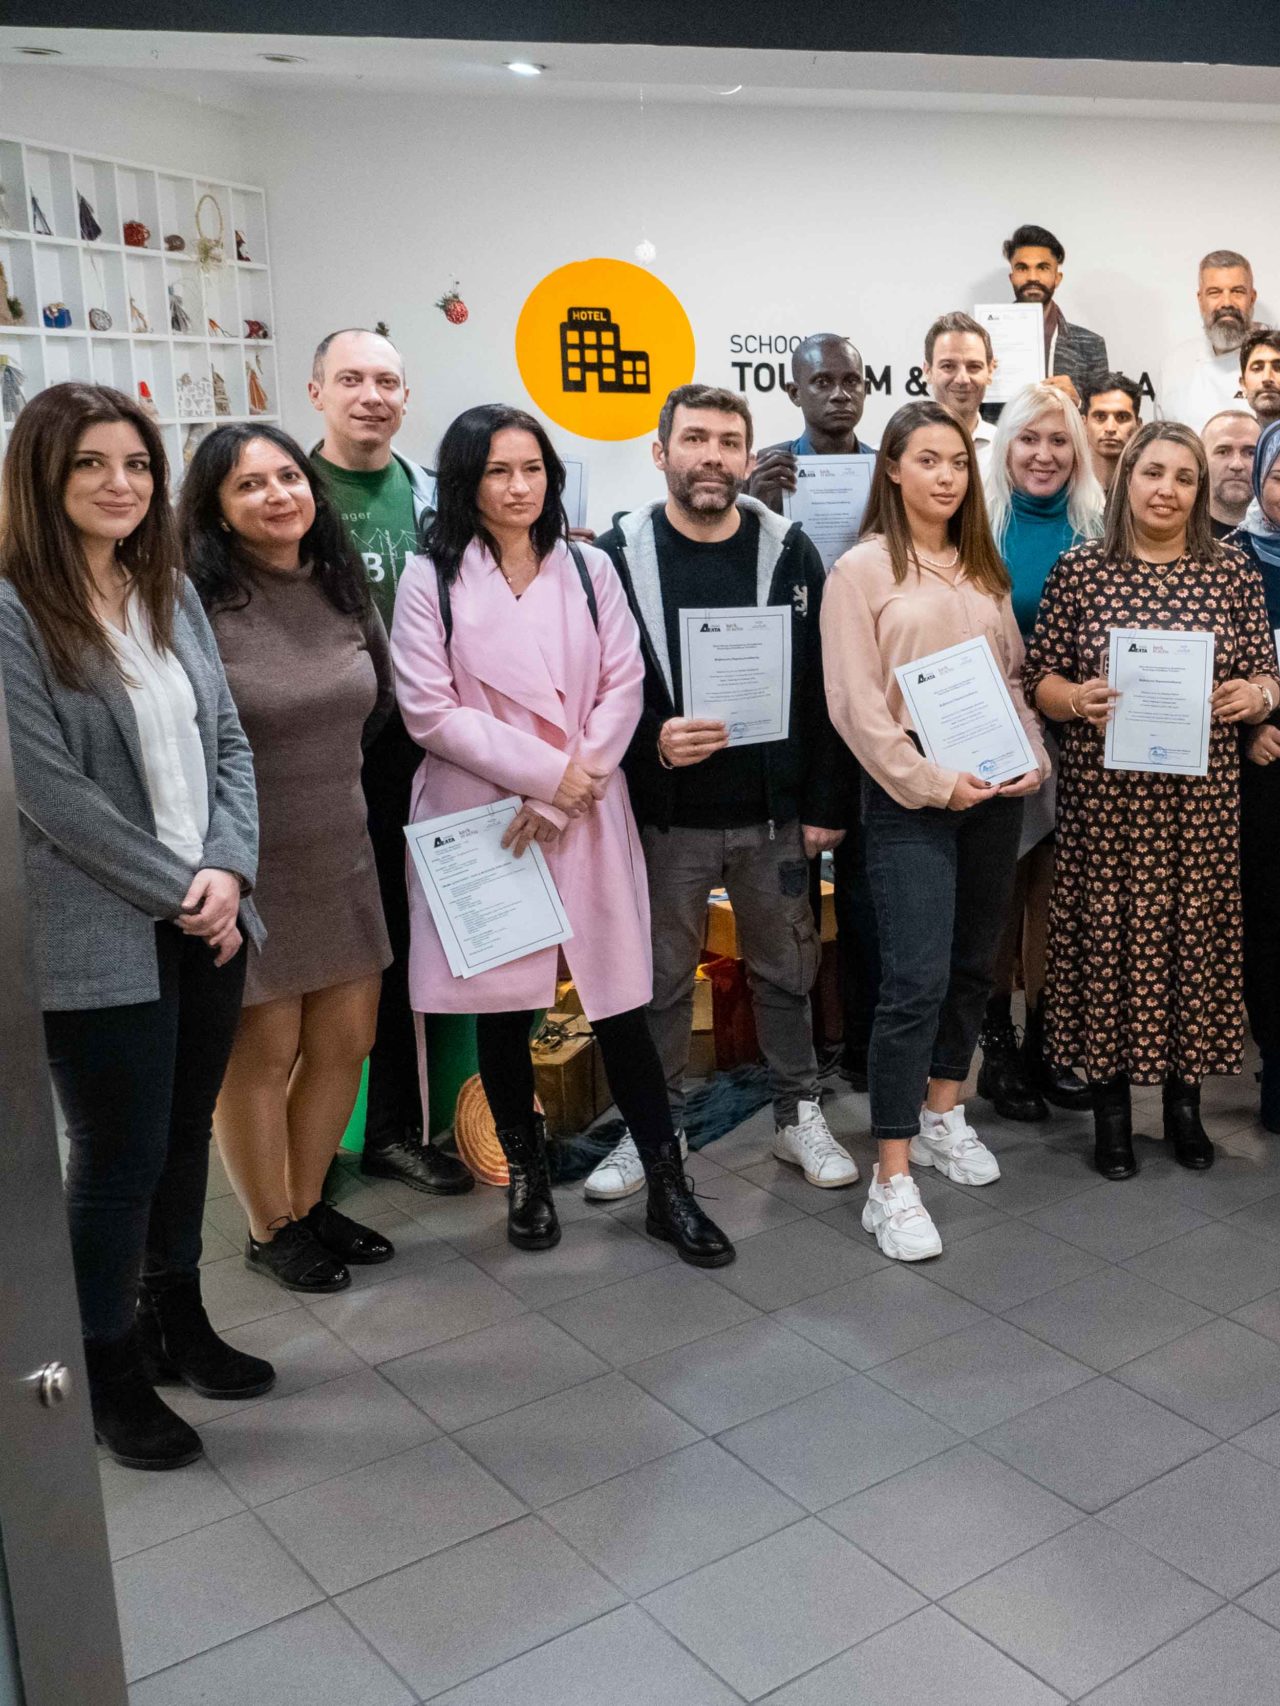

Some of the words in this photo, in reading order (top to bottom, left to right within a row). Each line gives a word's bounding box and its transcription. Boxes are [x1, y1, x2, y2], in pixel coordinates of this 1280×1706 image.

[572, 310, 607, 321] HOTEL
[730, 334, 808, 354] SCHOO
[341, 511, 372, 522] ager
